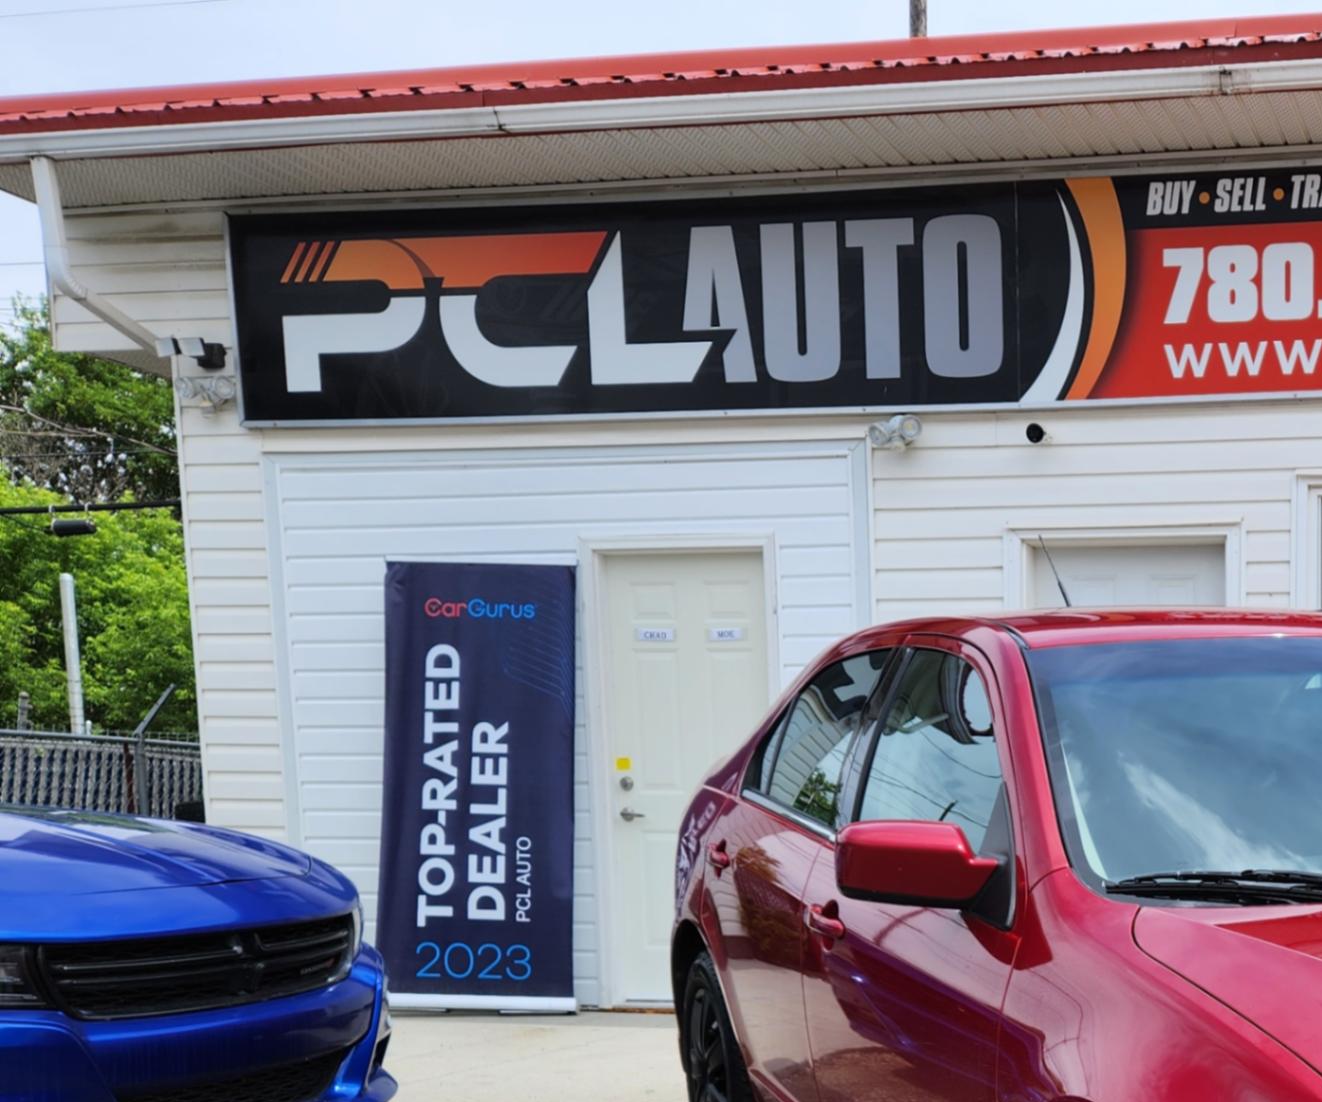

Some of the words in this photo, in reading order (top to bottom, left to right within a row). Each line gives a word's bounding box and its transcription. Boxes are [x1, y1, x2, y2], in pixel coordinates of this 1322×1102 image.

[1147, 179, 1195, 216] BUY
[1213, 177, 1266, 213] SELL
[280, 229, 714, 393] PCL
[682, 213, 1003, 384] AUTO
[424, 598, 536, 619] CarGurus
[417, 643, 461, 927] TOP-RATED
[467, 721, 509, 921] DEALER
[515, 836, 531, 886] AUTO
[515, 888, 531, 922] PCL
[415, 942, 532, 981] 2023
